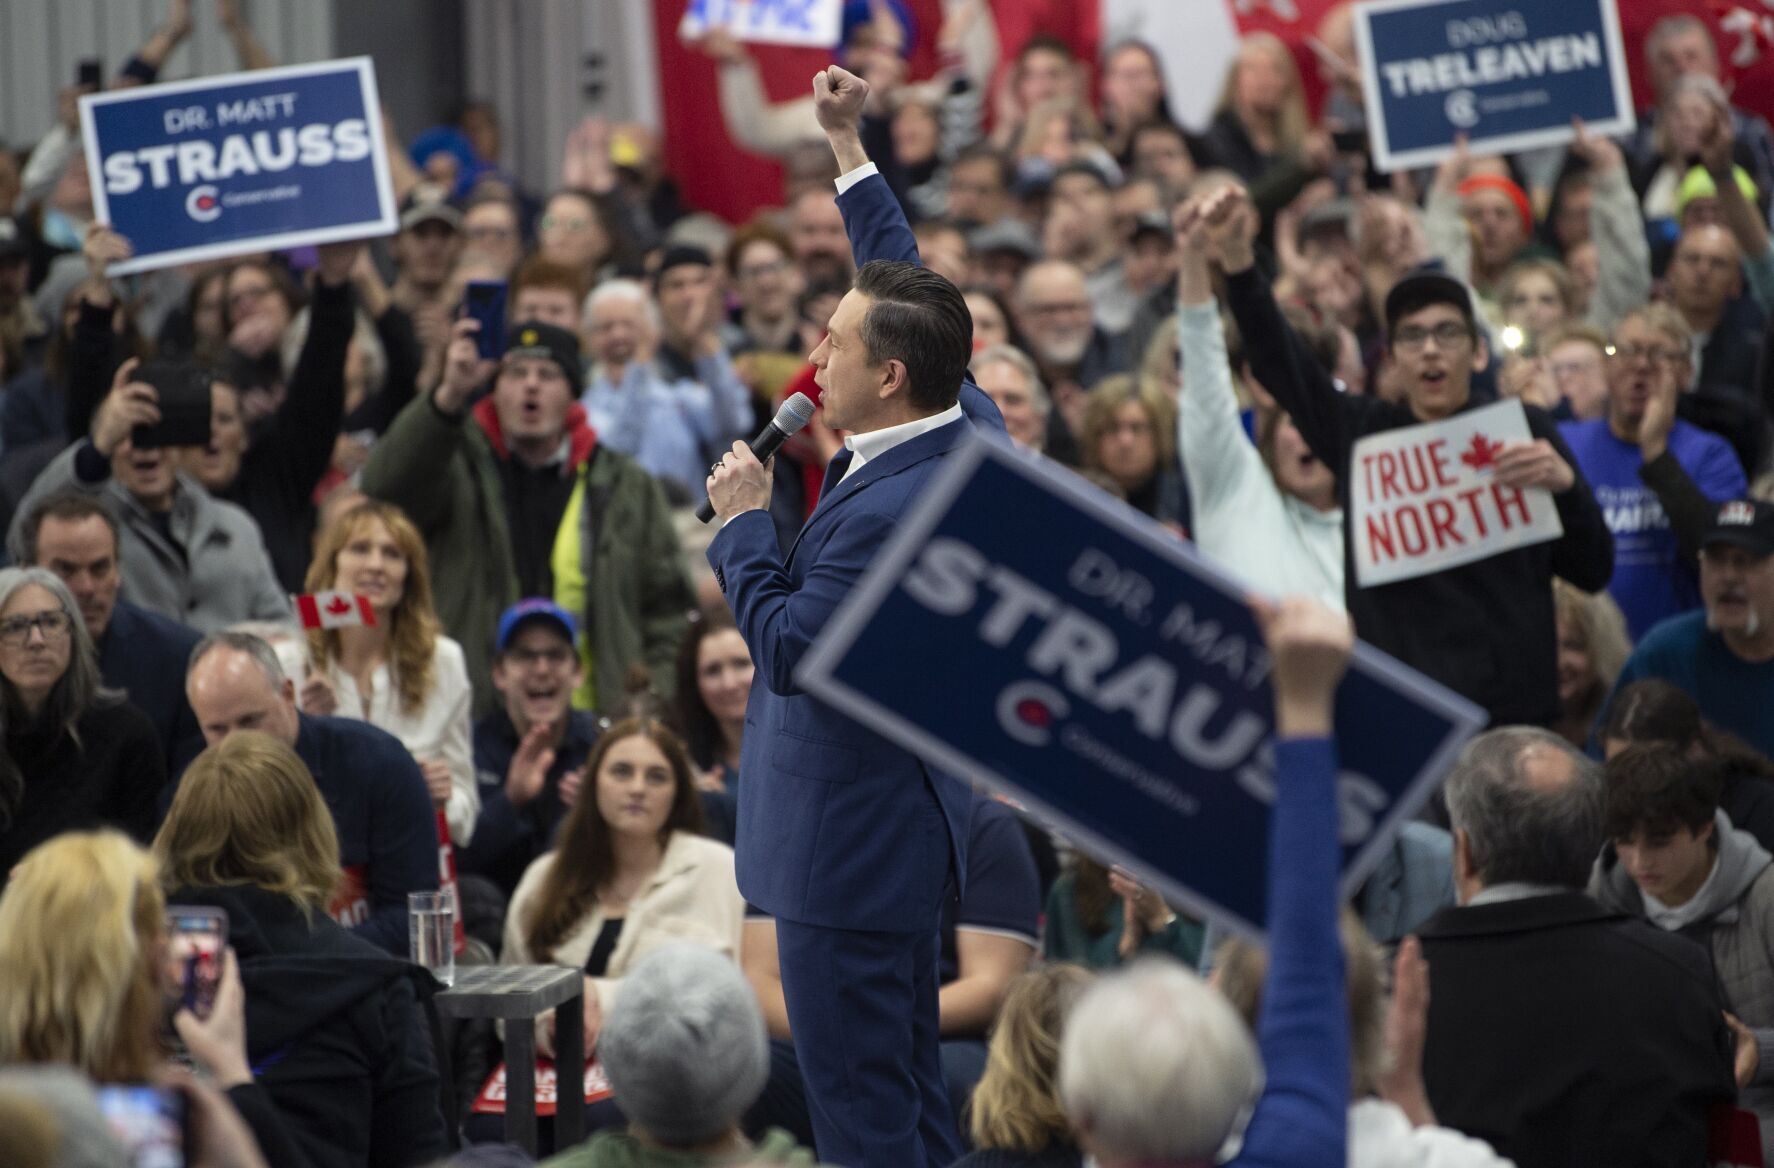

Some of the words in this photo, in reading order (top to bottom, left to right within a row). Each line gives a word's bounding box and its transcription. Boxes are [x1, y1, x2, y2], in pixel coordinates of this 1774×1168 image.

[1445, 10, 1528, 48] DOUG
[1382, 31, 1602, 98] TRELEAVEN
[163, 105, 213, 135] DR.
[216, 92, 297, 127] MATT
[103, 119, 371, 195] STRAUSS
[1362, 438, 1460, 503] TRUE
[1365, 480, 1532, 564] NORTH
[1067, 548, 1155, 626] DR.
[1159, 602, 1275, 690] MAT
